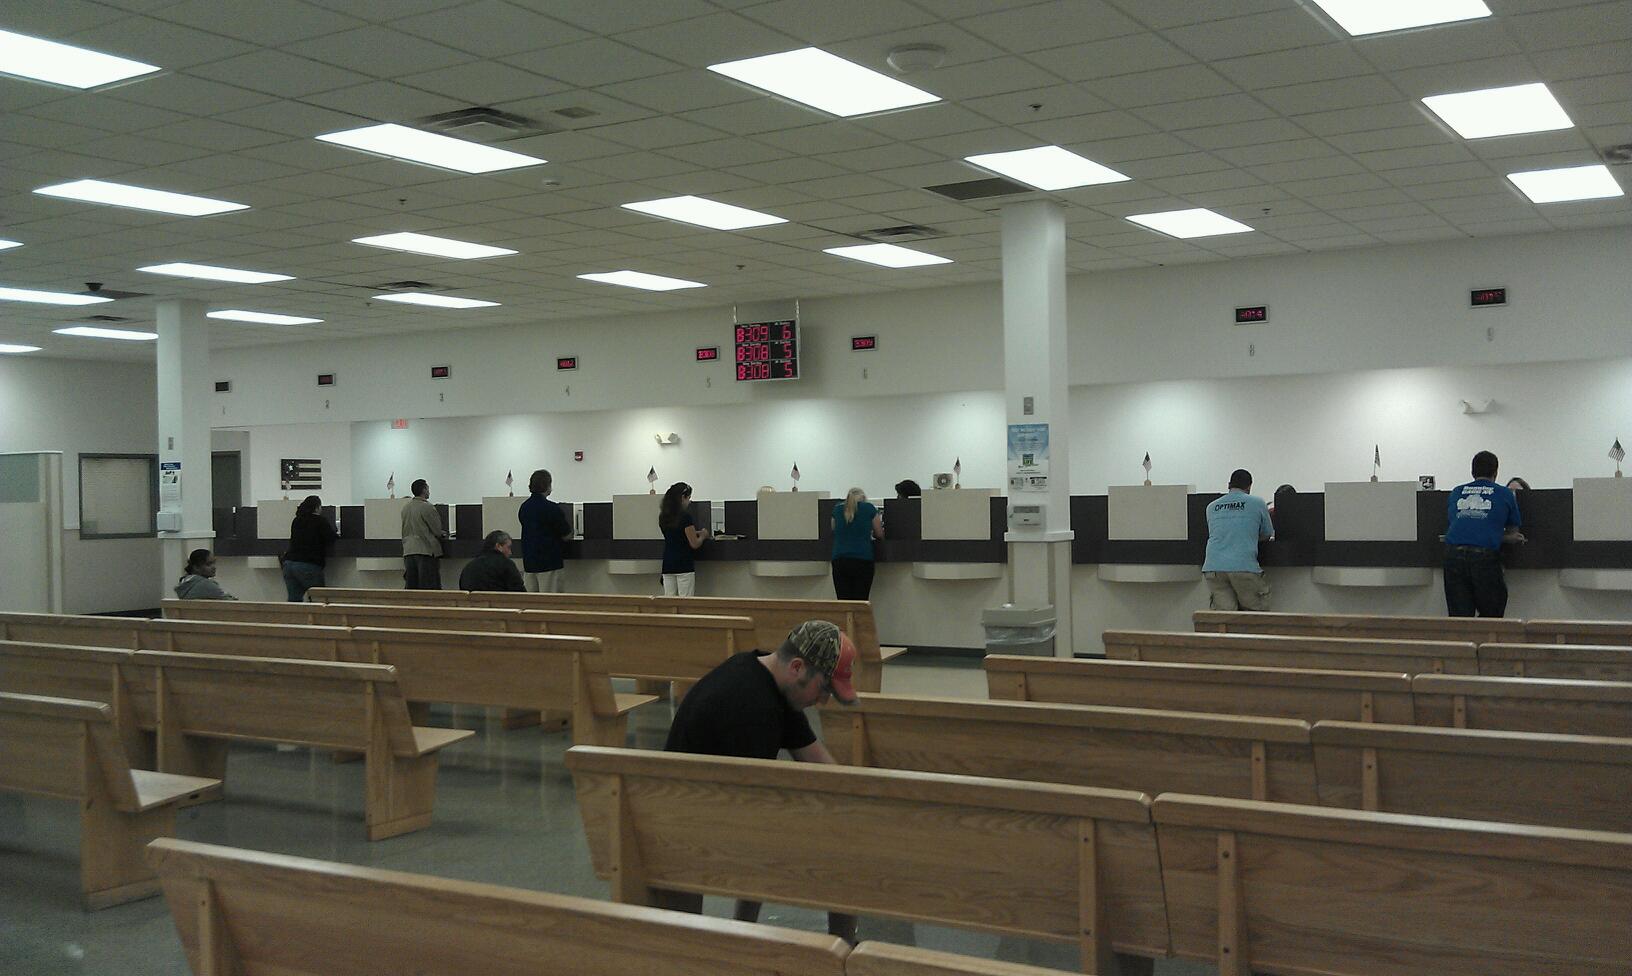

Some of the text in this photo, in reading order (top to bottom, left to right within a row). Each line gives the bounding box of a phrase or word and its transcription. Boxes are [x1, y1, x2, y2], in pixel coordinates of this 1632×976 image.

[736, 324, 792, 342] B309 6
[737, 342, 792, 361] B308 5
[784, 361, 793, 378] 5
[1215, 502, 1246, 511] OPTIMAX
